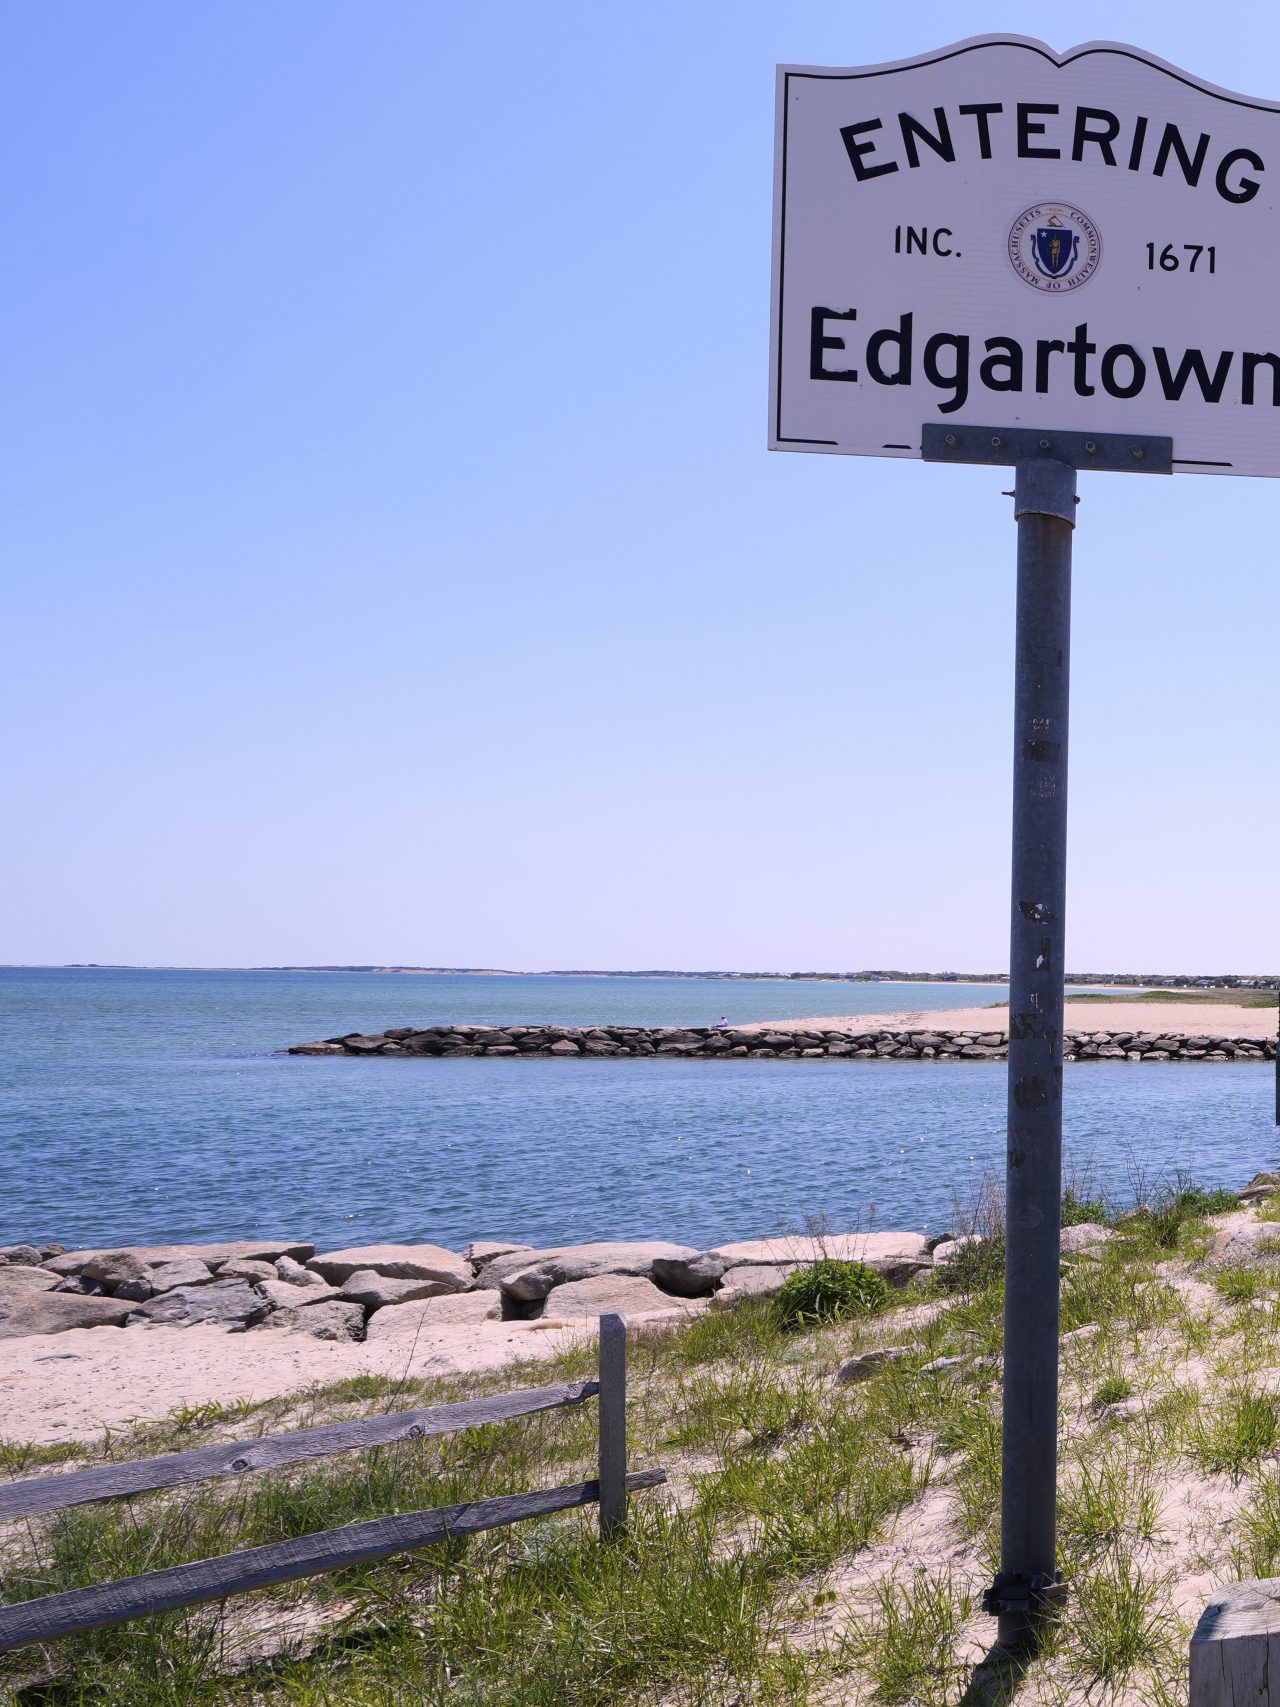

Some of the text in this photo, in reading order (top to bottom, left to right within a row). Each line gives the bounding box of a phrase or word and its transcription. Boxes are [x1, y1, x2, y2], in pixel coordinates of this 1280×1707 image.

[839, 102, 1265, 204] ENTERING
[895, 225, 1216, 274] INC. 1671
[1011, 209, 1097, 290] COMMONWEALTH OF MASSACHUSETTS
